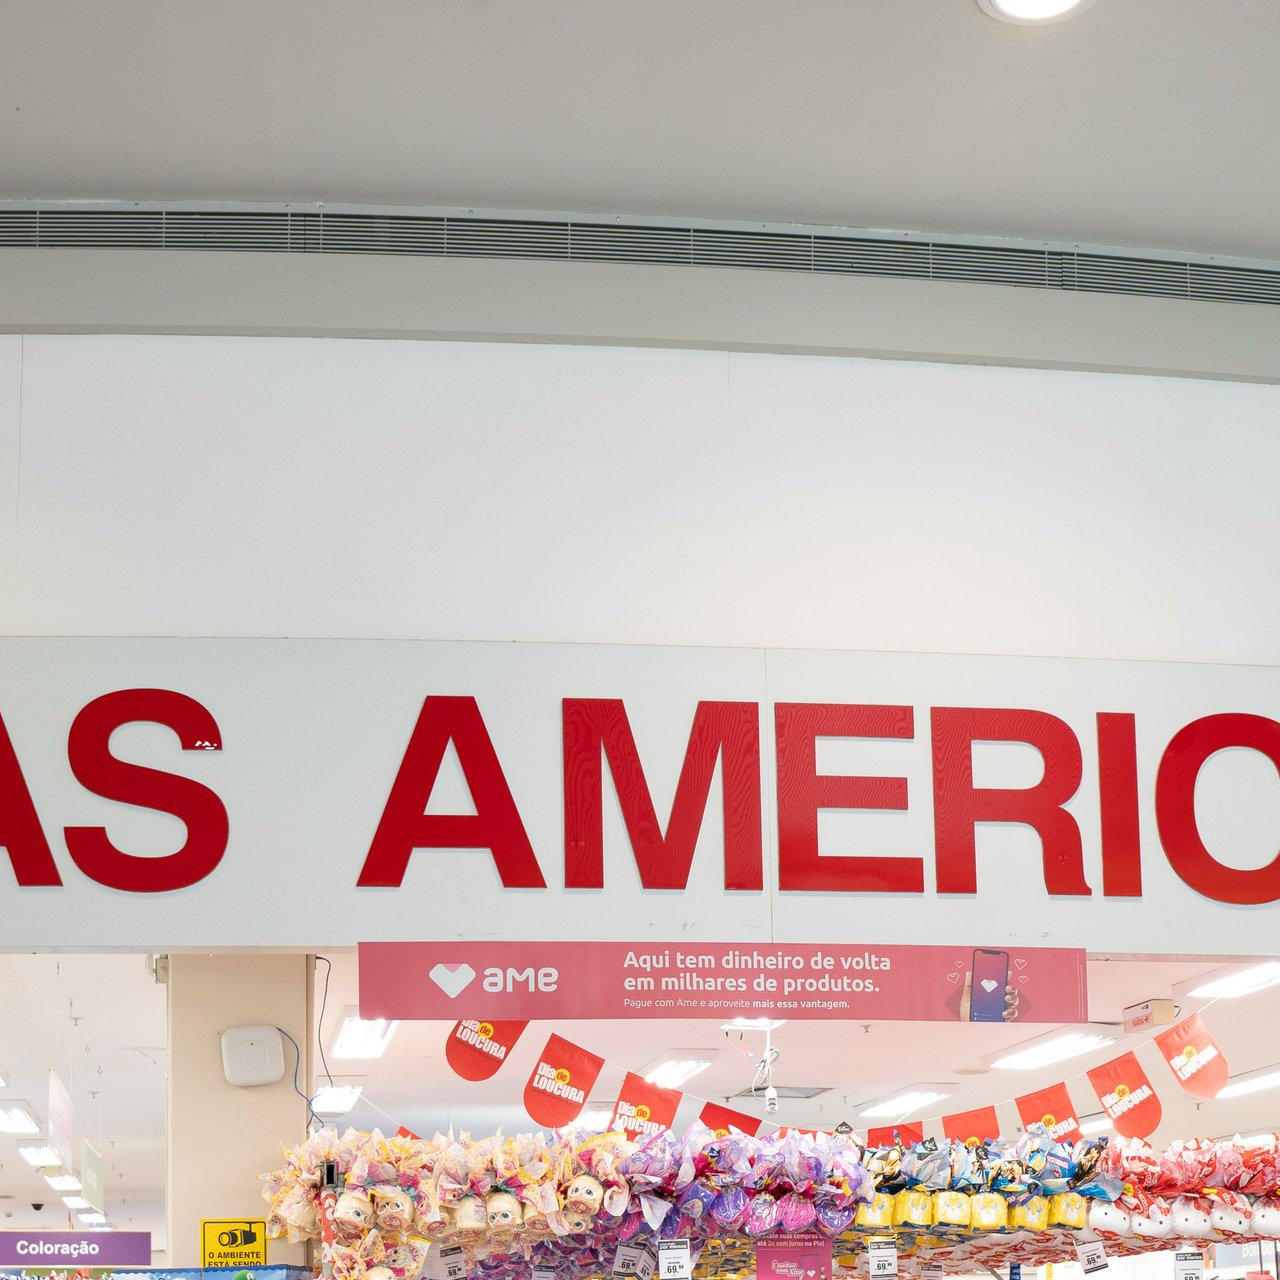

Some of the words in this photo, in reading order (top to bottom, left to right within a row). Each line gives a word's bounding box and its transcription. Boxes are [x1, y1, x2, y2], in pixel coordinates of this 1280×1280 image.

[624, 952, 669, 971] Aqui
[676, 953, 715, 969] tem
[721, 951, 804, 970] dinheiro
[810, 952, 834, 970] de
[840, 952, 890, 971] volta
[624, 977, 654, 991] em
[661, 973, 747, 992] milhares
[753, 974, 777, 992] de
[783, 976, 879, 995] produtos.
[624, 998, 653, 1009] Pague
[676, 999, 698, 1007] Ame
[708, 998, 750, 1010] aproveite
[752, 999, 774, 1008] mais
[800, 1000, 850, 1010] vantagem.
[456, 1025, 507, 1060] LOUCURA
[532, 1077, 585, 1104] LOUCURA
[1108, 1084, 1153, 1119] LOUCURA
[16, 1240, 100, 1258] Coloração
[218, 1251, 261, 1259] AMBIENTE
